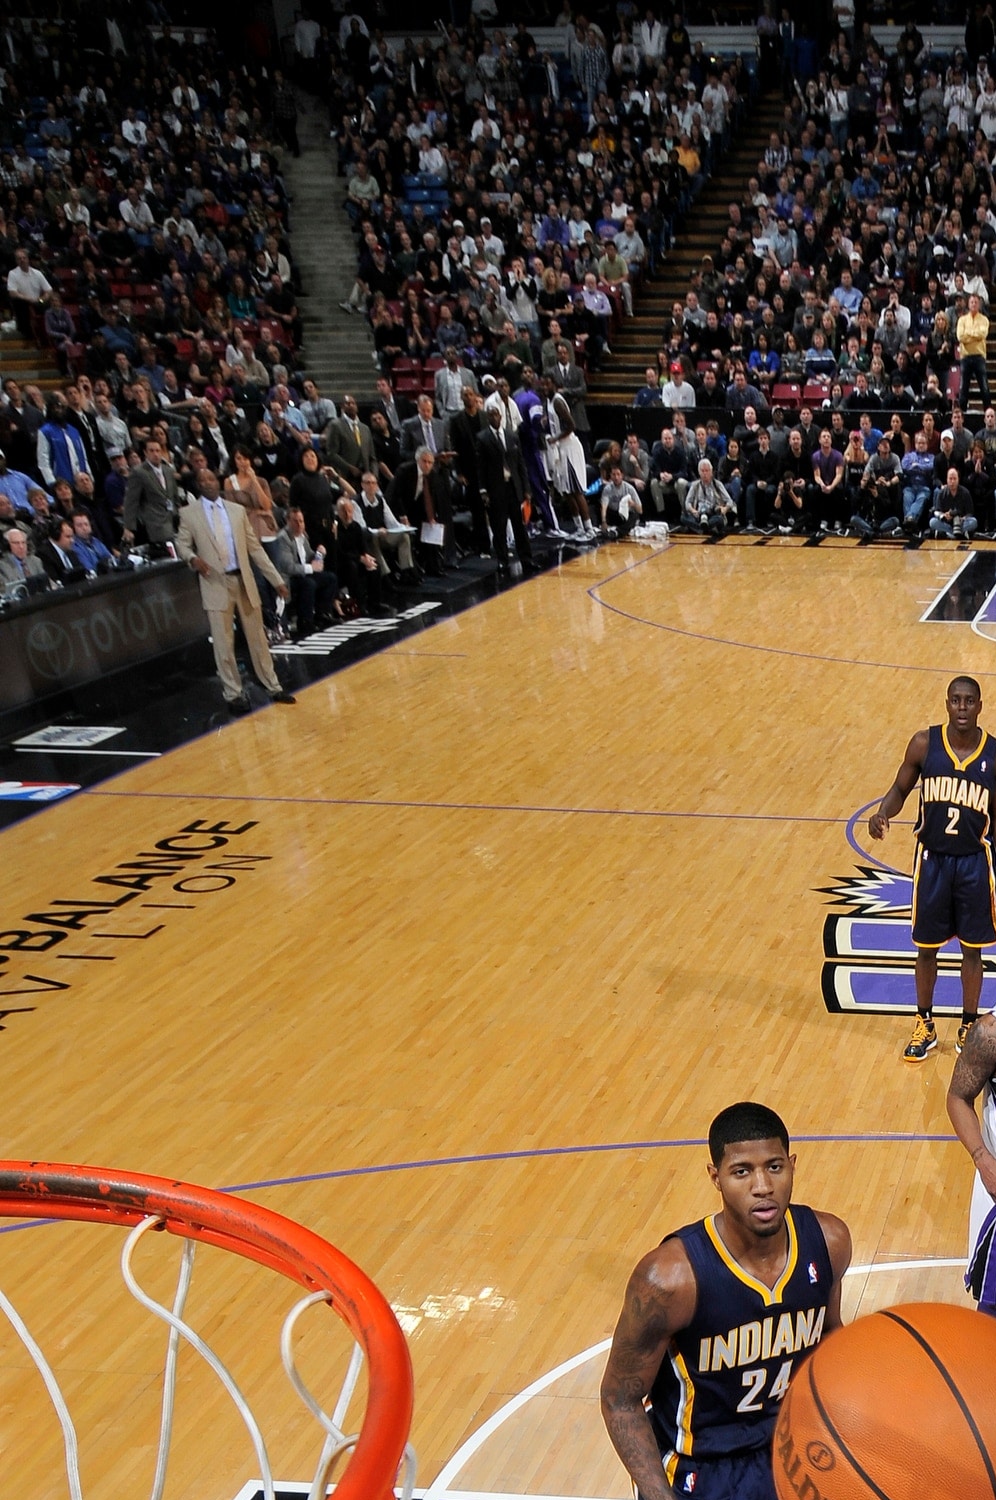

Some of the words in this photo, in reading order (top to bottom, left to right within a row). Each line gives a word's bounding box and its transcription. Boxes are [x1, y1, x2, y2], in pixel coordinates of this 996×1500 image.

[70, 592, 182, 658] TOYOTA
[924, 776, 989, 815] INDIANA
[944, 807, 960, 835] 2
[0, 854, 272, 1031] VILION
[699, 1306, 826, 1373] INDIANA
[736, 1359, 794, 1413] 24
